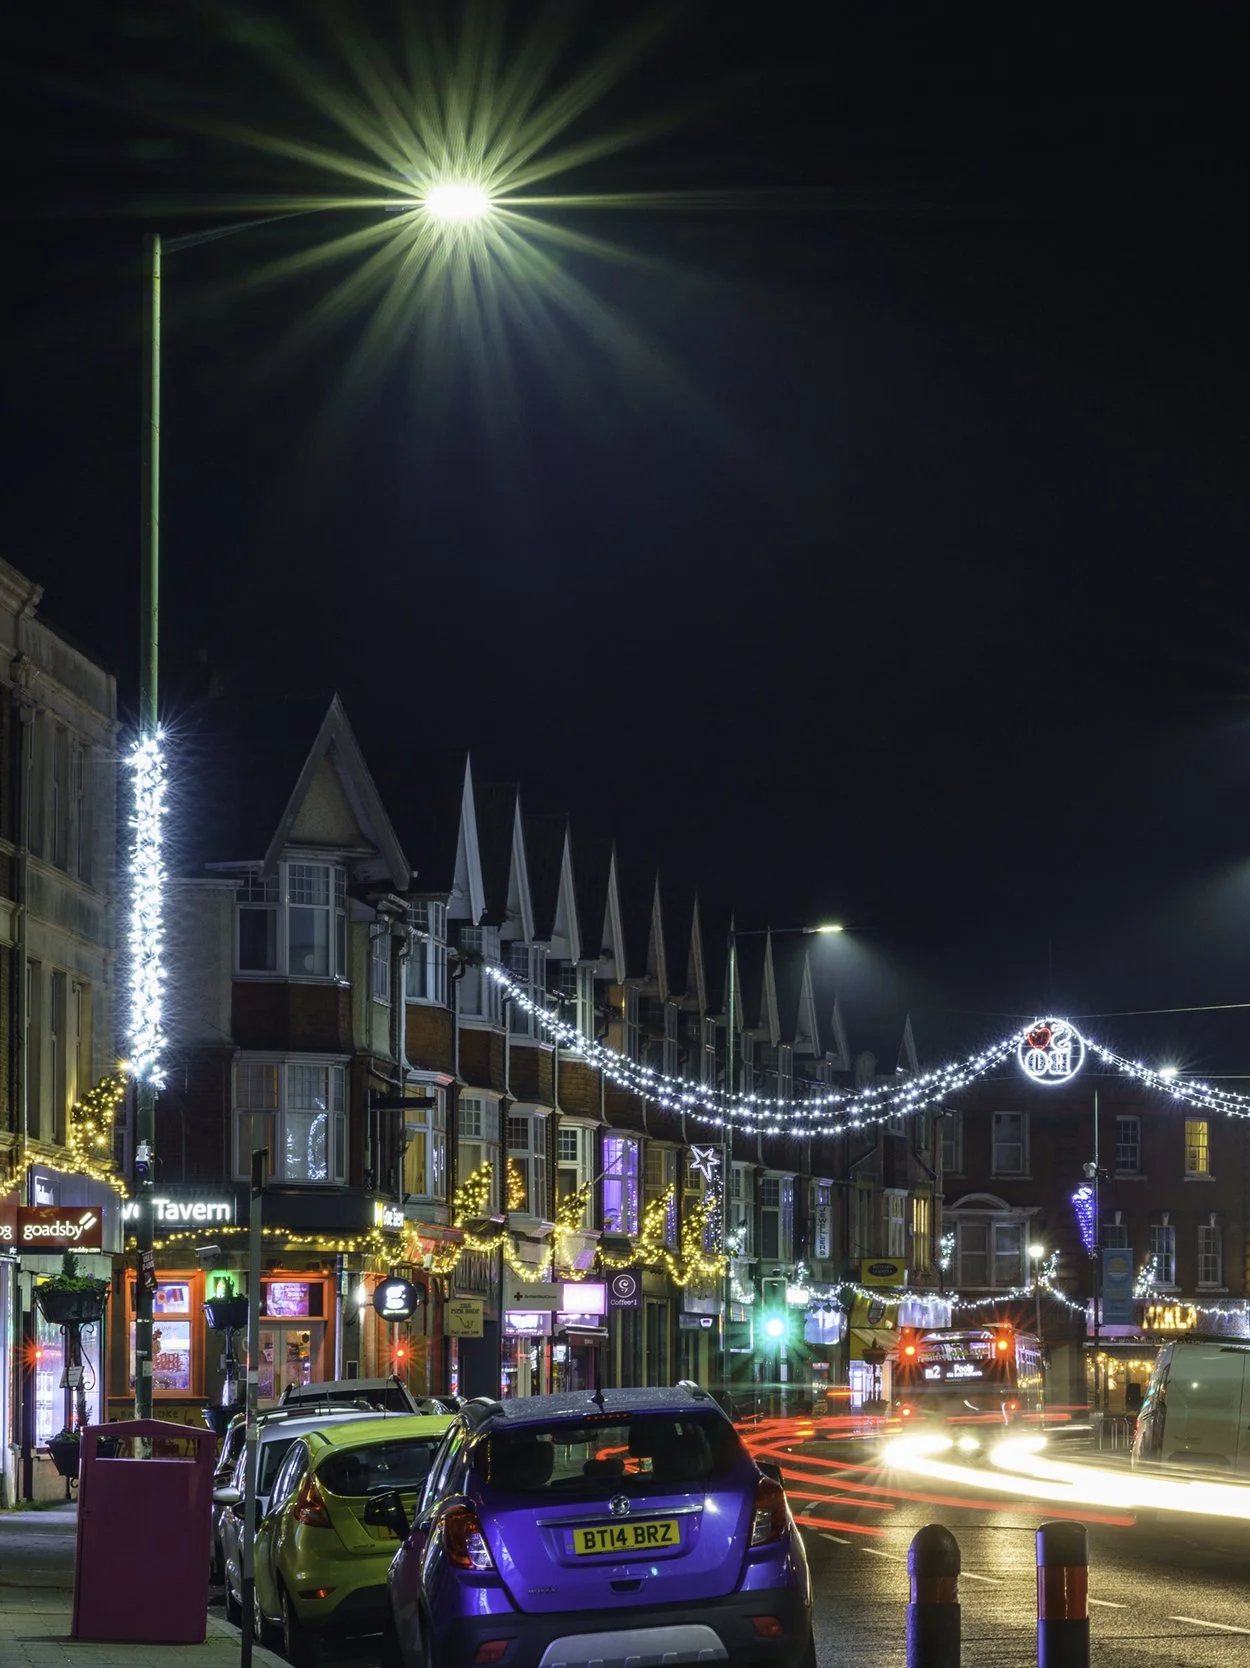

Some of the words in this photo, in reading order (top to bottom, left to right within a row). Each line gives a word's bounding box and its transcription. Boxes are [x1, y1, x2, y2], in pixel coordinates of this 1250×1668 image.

[152, 1199, 230, 1220] Tavern
[23, 1220, 83, 1240] goadsby
[925, 1365, 941, 1379] m2
[583, 1528, 628, 1550] BT14
[634, 1524, 672, 1544] BRZ
